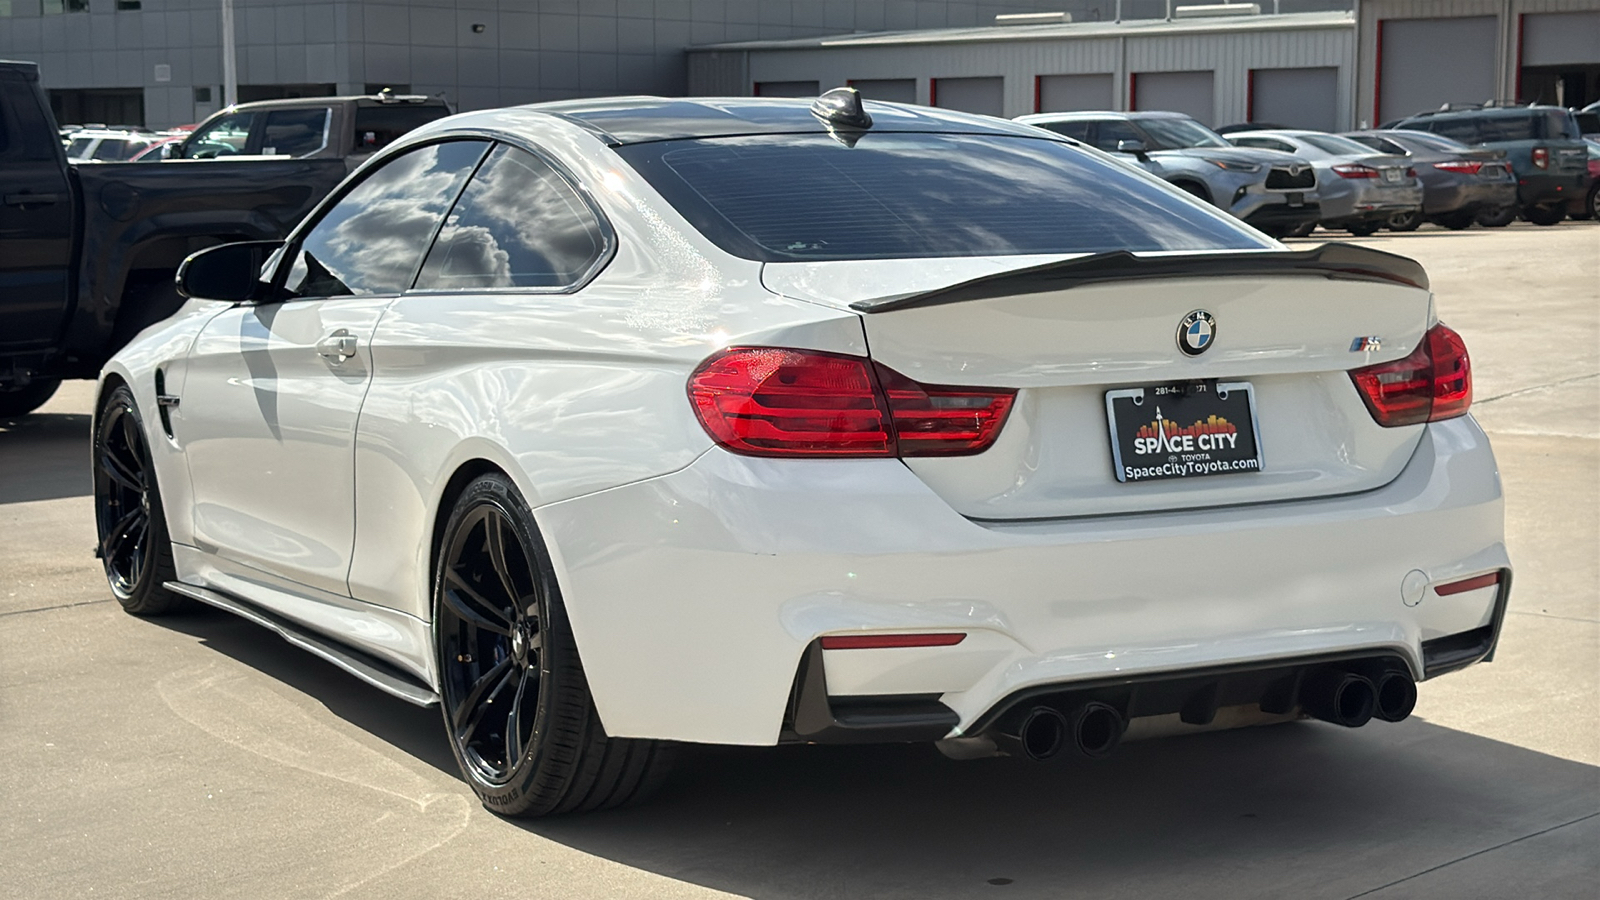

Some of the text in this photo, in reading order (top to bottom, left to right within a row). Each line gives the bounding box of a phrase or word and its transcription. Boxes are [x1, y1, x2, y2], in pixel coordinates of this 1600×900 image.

[1183, 312, 1216, 328] BMW
[1134, 432, 1238, 455] SPACE CITY
[1181, 453, 1211, 462] TOYOTA
[1125, 458, 1258, 480] SpaceCityToyota.com
